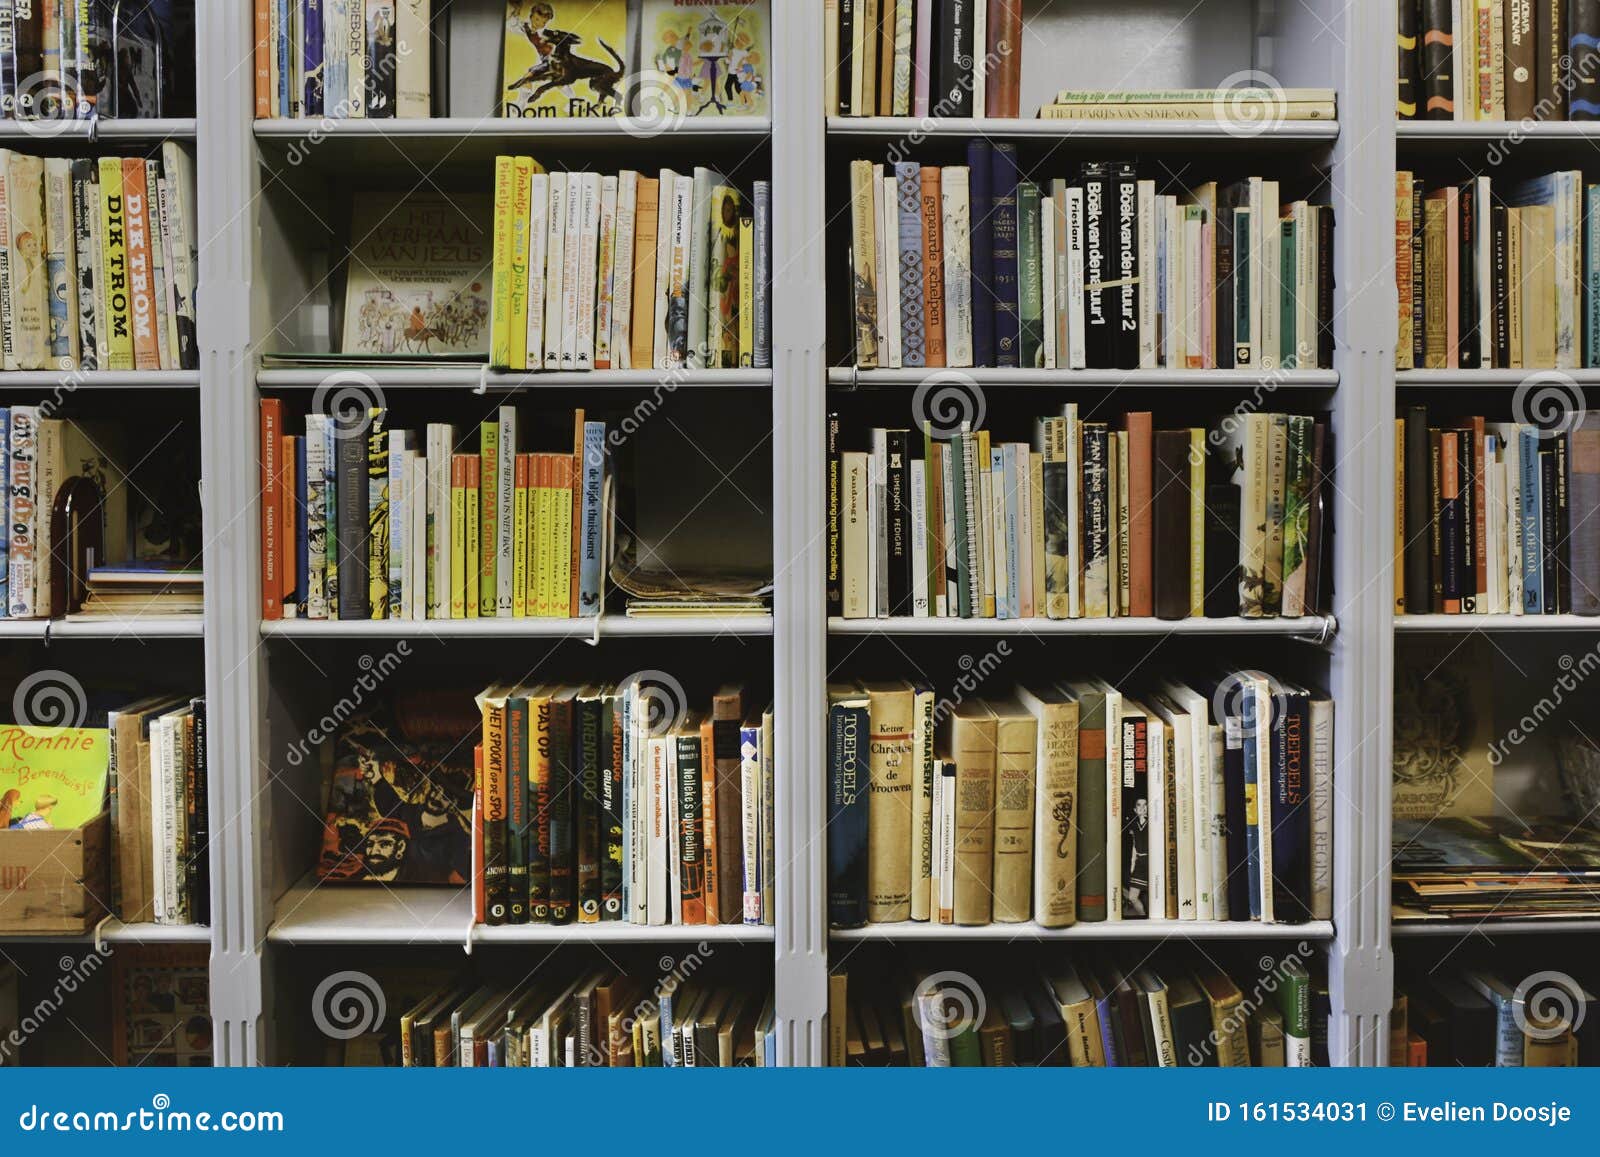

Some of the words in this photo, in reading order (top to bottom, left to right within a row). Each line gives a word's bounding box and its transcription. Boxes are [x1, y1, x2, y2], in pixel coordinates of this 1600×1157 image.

[506, 103, 556, 117] Dom
[498, 162, 511, 216] Pinkeltje
[514, 166, 529, 215] Pinkeltje
[107, 195, 123, 248] DIK
[127, 194, 145, 249] DIK
[408, 208, 447, 225] HET
[925, 196, 941, 260] gepaarde
[1071, 198, 1080, 250] Friesland
[1397, 220, 1411, 236] DE
[374, 227, 473, 243] VERHAAL
[370, 246, 417, 261] VAN
[423, 246, 482, 262] JEZUS
[512, 263, 526, 290] Dick
[1026, 258, 1036, 304] JOANNES
[1397, 239, 1411, 304] KINDEREN
[111, 254, 127, 338] TROM
[133, 253, 151, 338] TROM
[926, 266, 941, 325] schelpen
[1122, 319, 1136, 330] 2
[484, 448, 496, 472] PIM
[1092, 440, 1101, 461] JAN
[1274, 434, 1283, 467] liefde
[484, 475, 494, 490] en
[588, 468, 599, 480] de
[829, 460, 839, 515] kennismaking
[484, 491, 496, 520] PAM
[586, 481, 599, 506] blijde
[849, 467, 858, 514] Vandaag
[893, 473, 901, 511] SIMENON
[503, 515, 511, 534] NIET
[830, 516, 838, 532] met
[1120, 505, 1128, 526] WAT
[484, 523, 496, 577] omnibus
[586, 508, 599, 560] thuiskomst
[894, 518, 902, 556] PEDIGREE
[1120, 530, 1128, 559] VLIEGT
[829, 533, 839, 580] Terschelling
[490, 708, 502, 730] HET
[537, 703, 549, 734] PAS
[880, 724, 904, 733] Ketter
[1, 728, 95, 760] Ronnie
[489, 732, 502, 772] SPOOKT
[511, 709, 522, 773] Mexicaans
[537, 736, 549, 759] OP
[583, 711, 597, 800] ARENDSOOG
[654, 745, 661, 754] de
[923, 700, 932, 784] TOPSCHAATSEN
[1124, 722, 1134, 758] JACQUELINE
[843, 713, 857, 805] TOEPOELS
[886, 770, 898, 780] de
[1124, 760, 1134, 787] KENNEDY
[1288, 714, 1301, 804] TOEPOELS
[1313, 720, 1328, 823] WILHELMINA
[18, 765, 95, 796] Berenhuisje
[490, 772, 498, 783] OP
[490, 784, 498, 795] DE
[683, 768, 696, 809] Nelleke's
[870, 783, 912, 793] Vrouwen
[923, 785, 931, 798] 72
[512, 774, 522, 824] avontuur
[604, 800, 612, 810] IN
[680, 812, 697, 862] opvoeding
[922, 811, 931, 834] THEO
[921, 836, 931, 879] KOOMEN
[1313, 831, 1328, 894] REGINA
[706, 869, 715, 893] vissen
